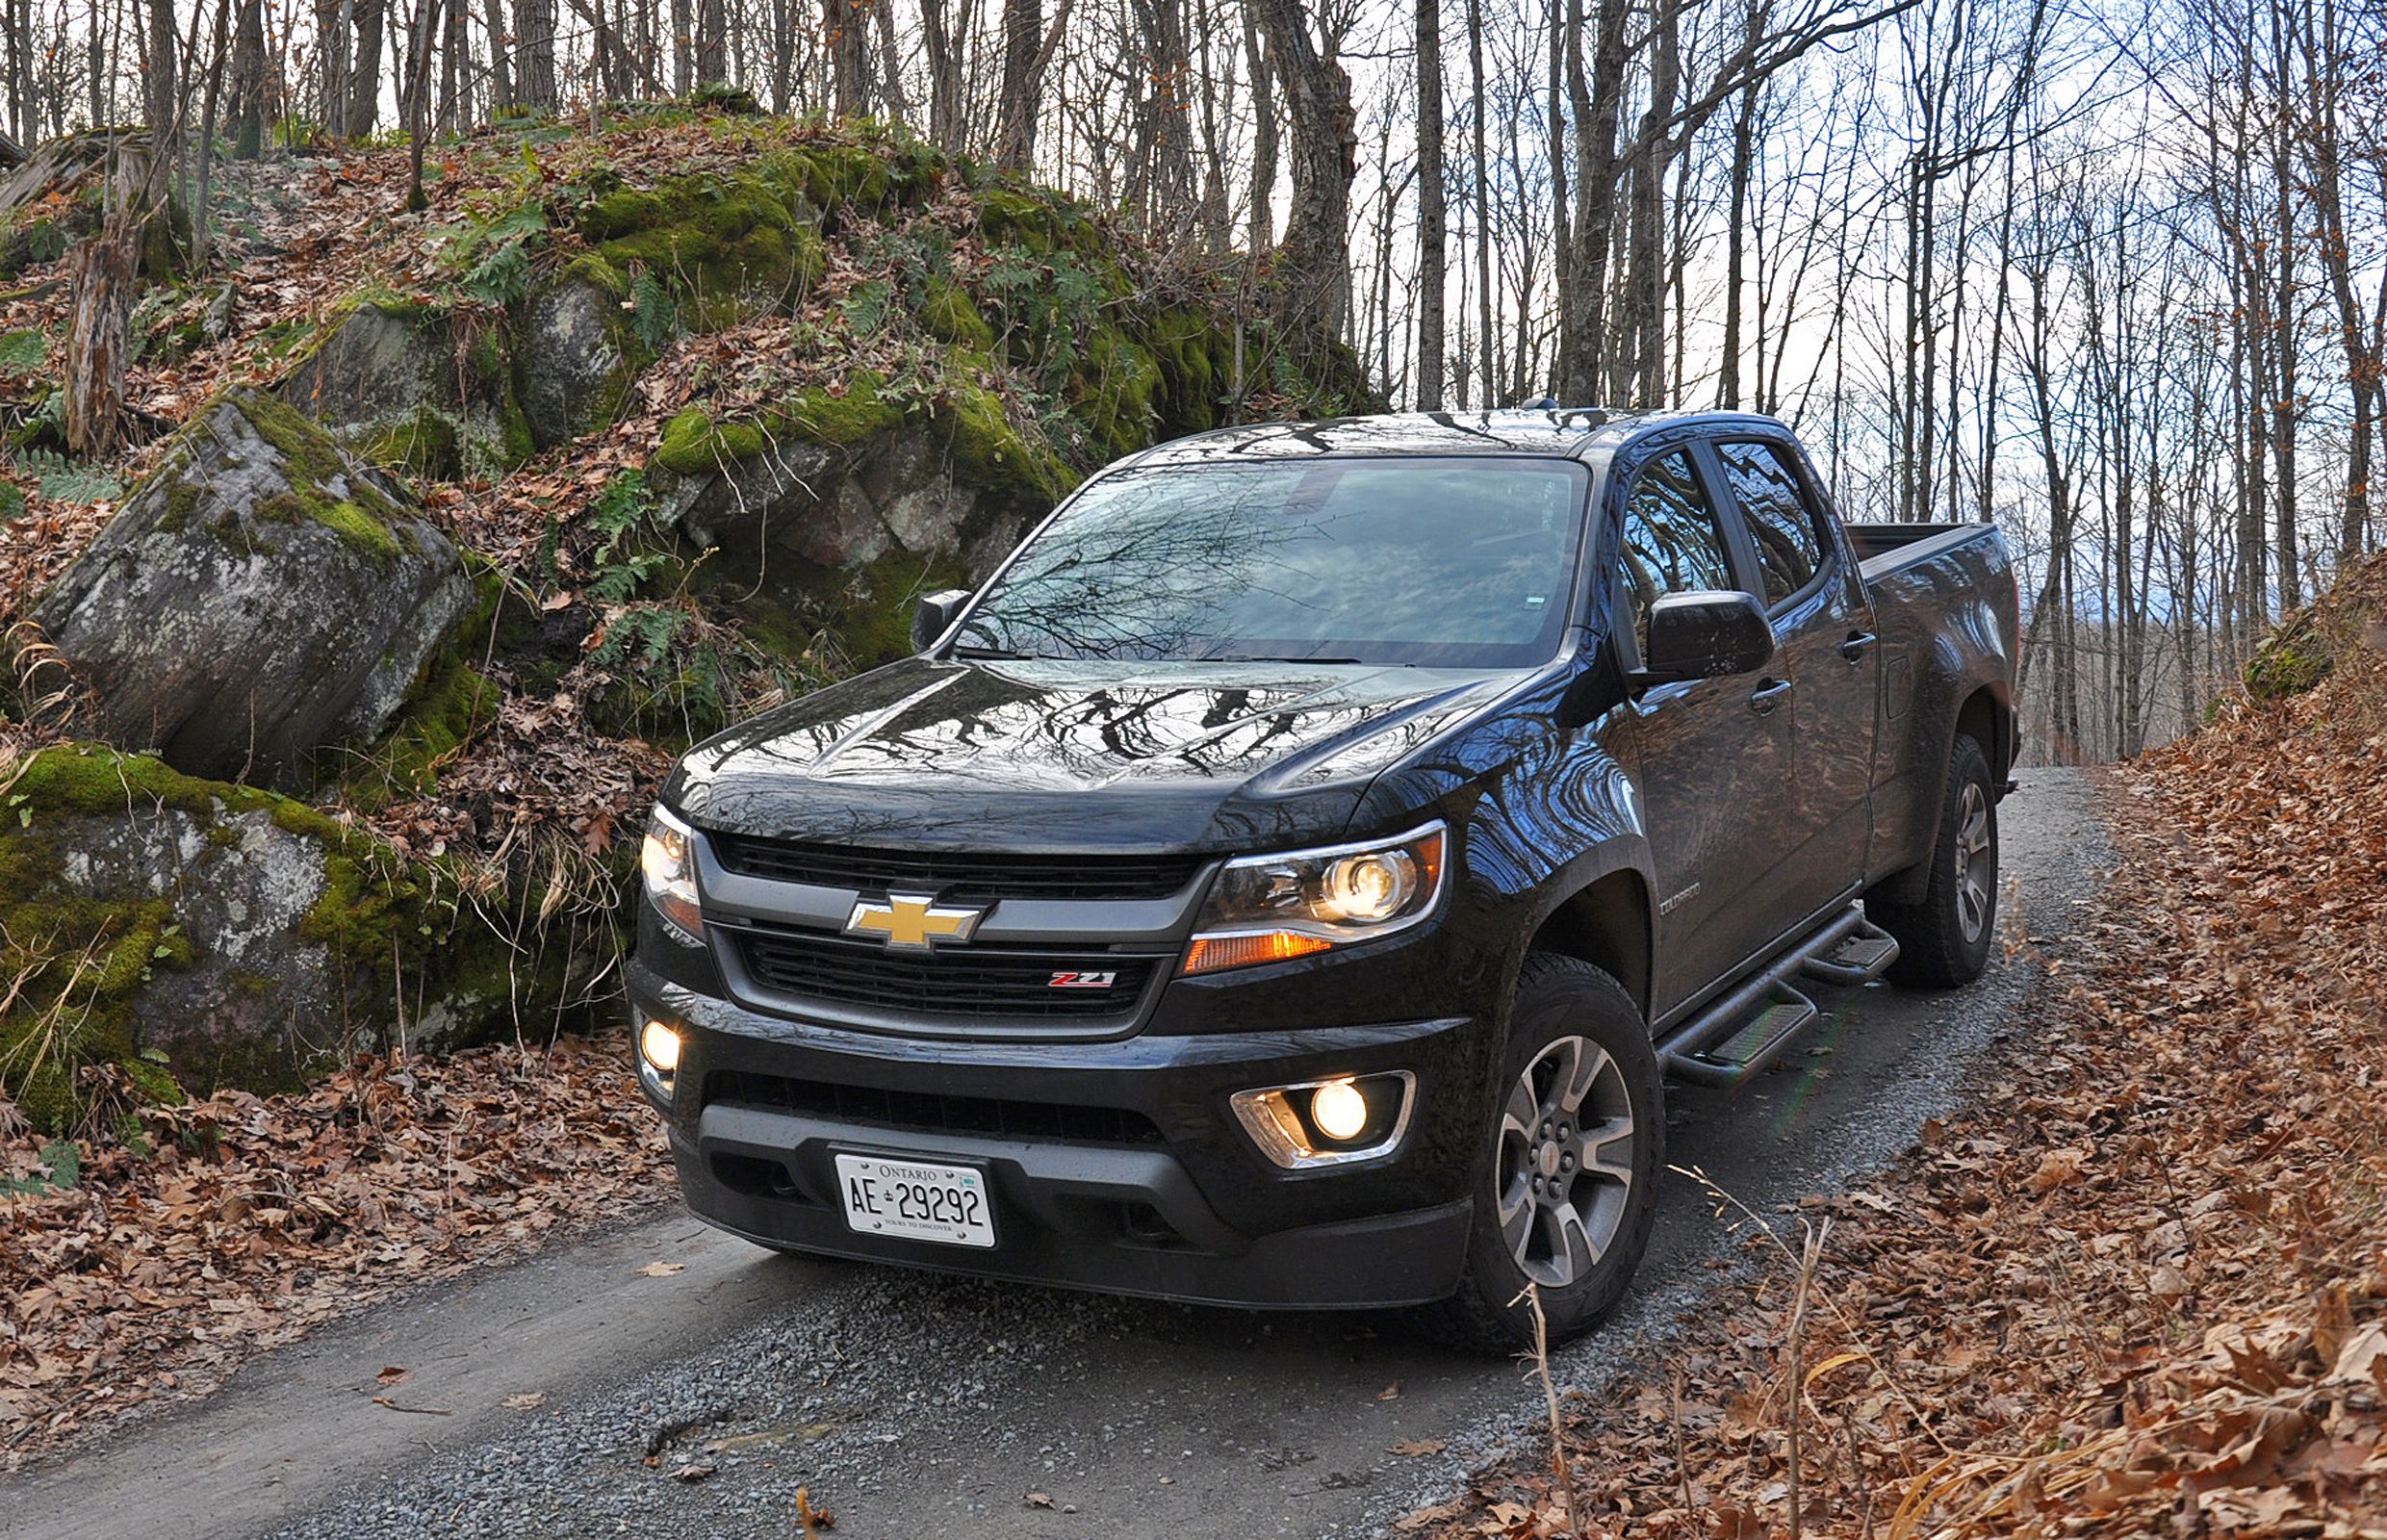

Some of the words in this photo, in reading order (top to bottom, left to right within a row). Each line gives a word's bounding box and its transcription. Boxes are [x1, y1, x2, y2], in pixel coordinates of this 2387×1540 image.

[1048, 972, 1116, 988] Z71
[880, 1165, 937, 1181] ONTARIO
[850, 1177, 883, 1215] AE
[896, 1183, 983, 1226] 29292
